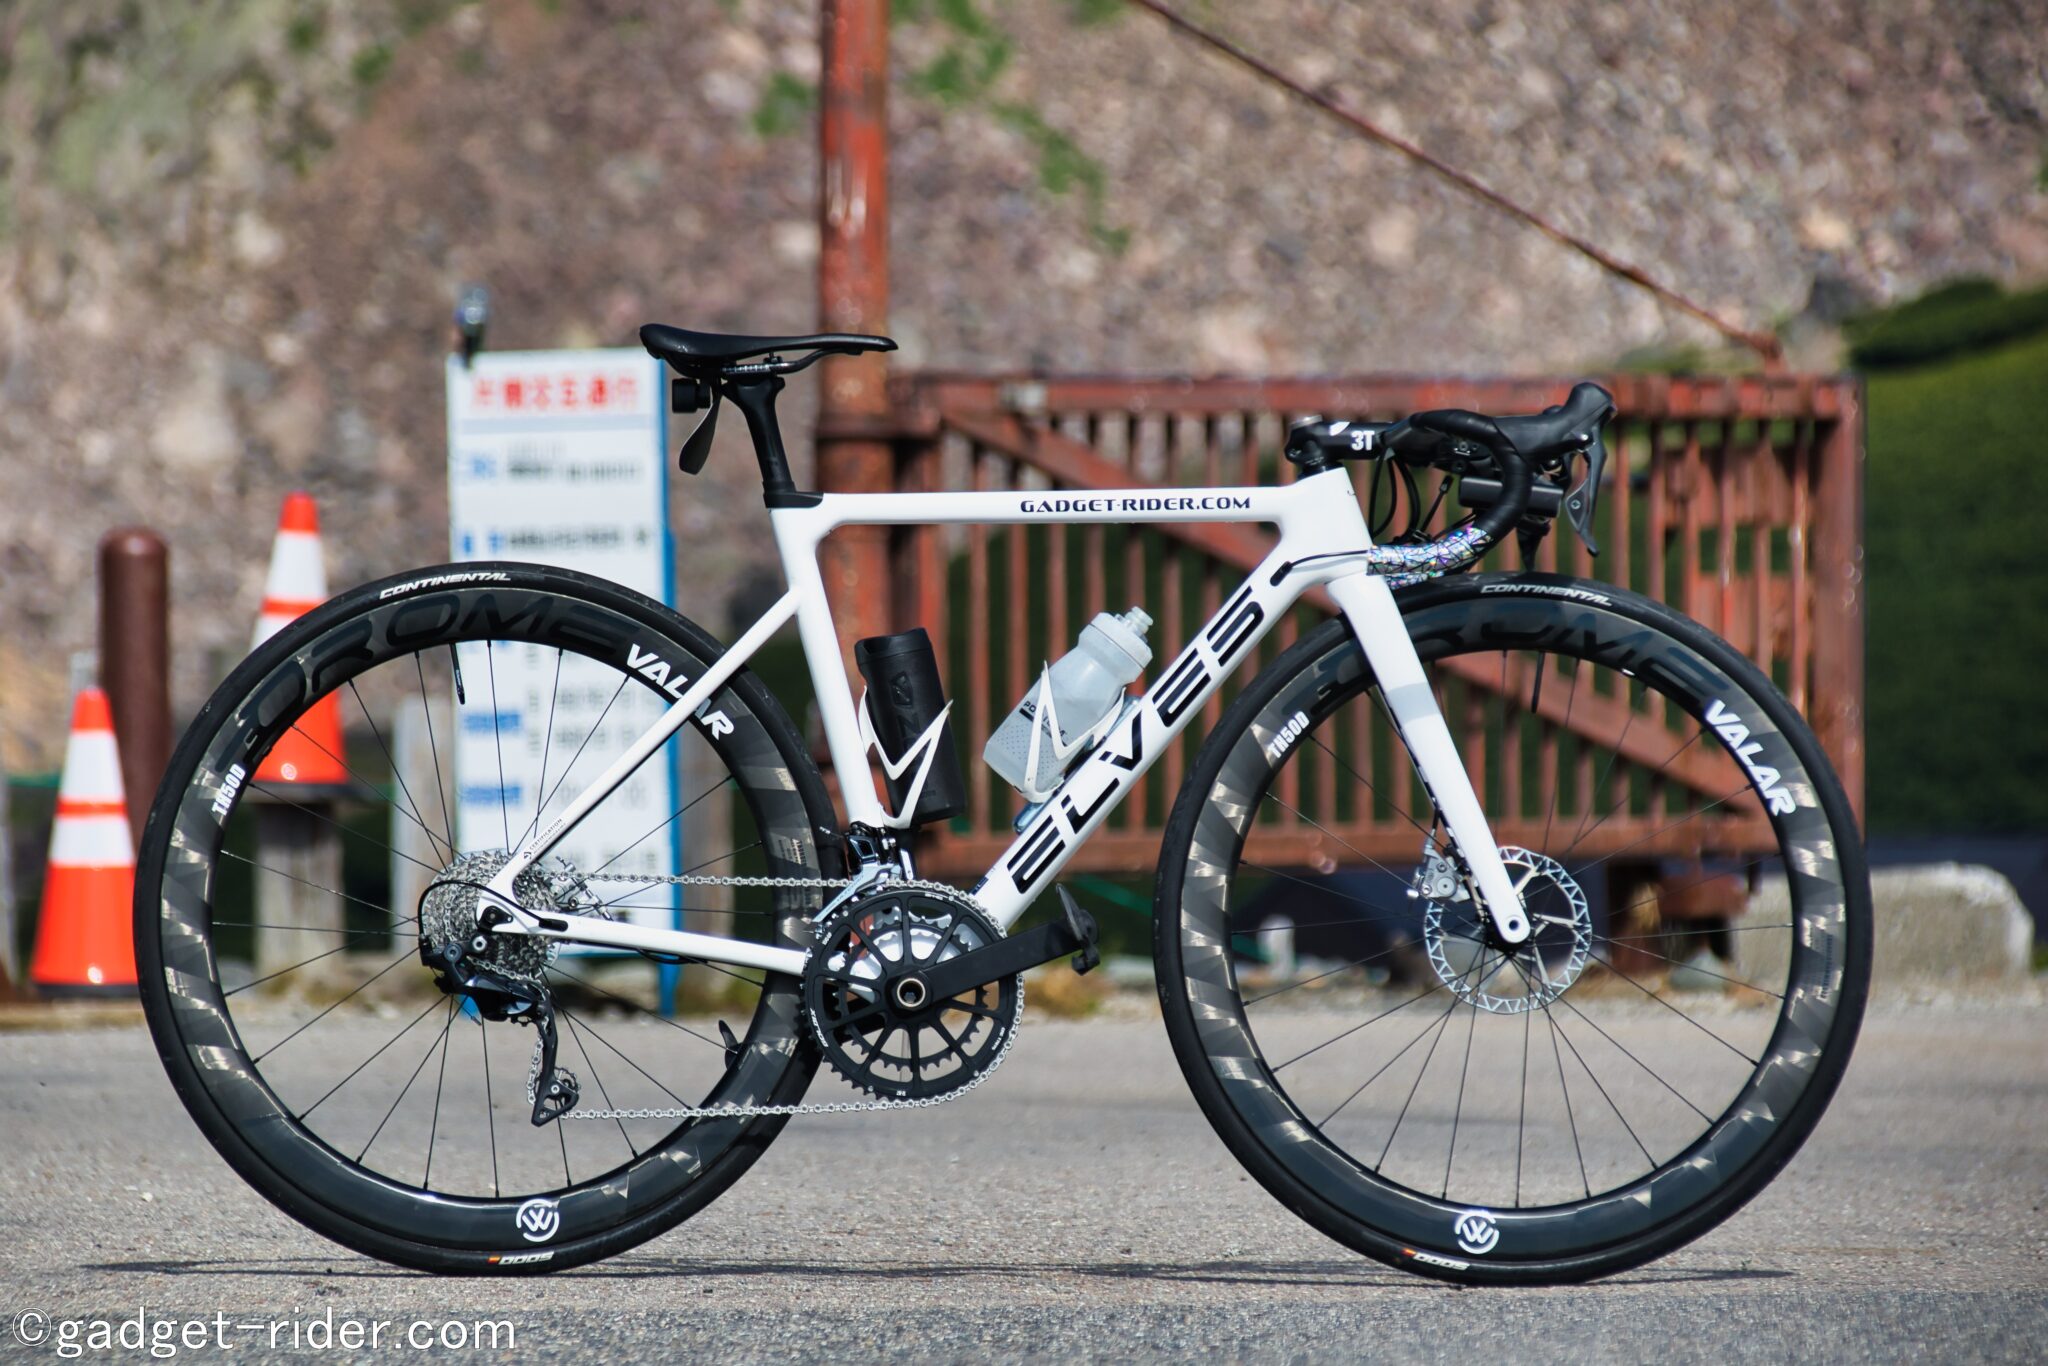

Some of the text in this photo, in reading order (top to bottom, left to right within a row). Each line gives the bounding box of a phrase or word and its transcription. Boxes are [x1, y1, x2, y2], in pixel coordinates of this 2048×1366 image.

[1351, 430, 1376, 451] 3T
[1019, 496, 1251, 513] GADGET-RIDER.COM
[379, 571, 511, 600] CONTINENTAL
[1480, 584, 1612, 607] CONTINENTAL
[1006, 584, 1265, 895] ELVES
[1267, 710, 1310, 760] TH50D
[1704, 698, 1797, 816] VALAR
[211, 763, 246, 816] TH50D
